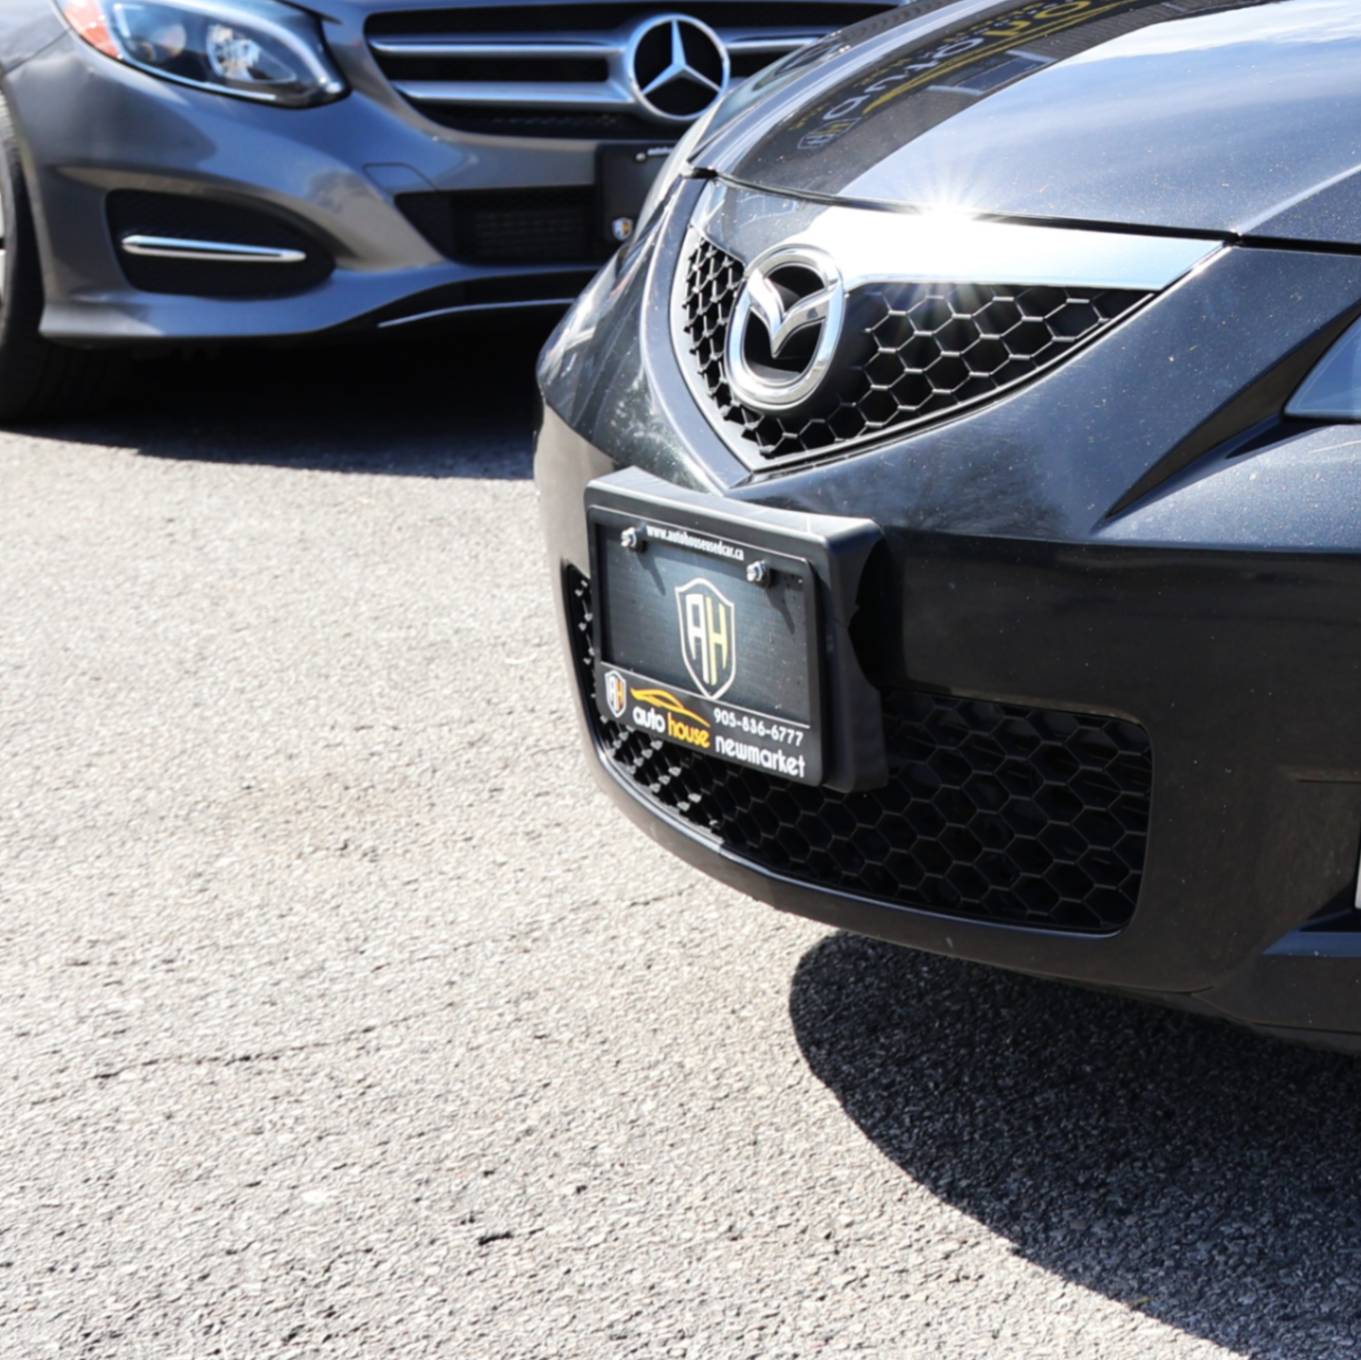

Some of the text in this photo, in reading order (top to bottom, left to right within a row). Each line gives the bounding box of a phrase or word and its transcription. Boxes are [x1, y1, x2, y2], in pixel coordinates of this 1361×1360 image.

[685, 593, 728, 686] AH
[713, 707, 804, 747] 905-836-6777
[714, 734, 806, 779] newmarket
